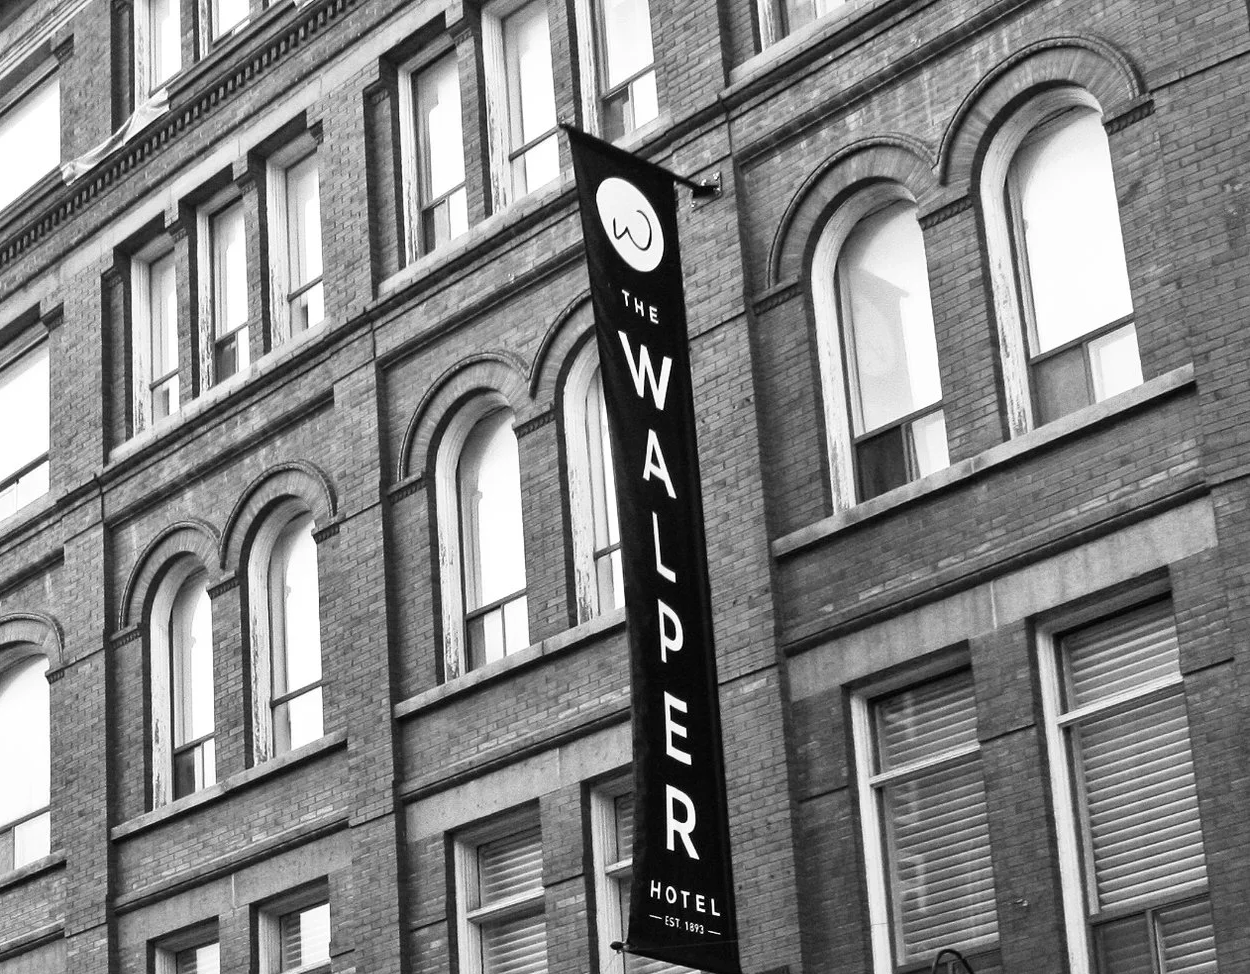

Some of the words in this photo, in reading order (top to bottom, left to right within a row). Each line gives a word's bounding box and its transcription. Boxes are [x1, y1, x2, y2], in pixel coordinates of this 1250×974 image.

[621, 288, 659, 325] THE
[618, 330, 699, 860] WALPER
[650, 879, 721, 917] HOTEL
[684, 921, 704, 935] 1893
